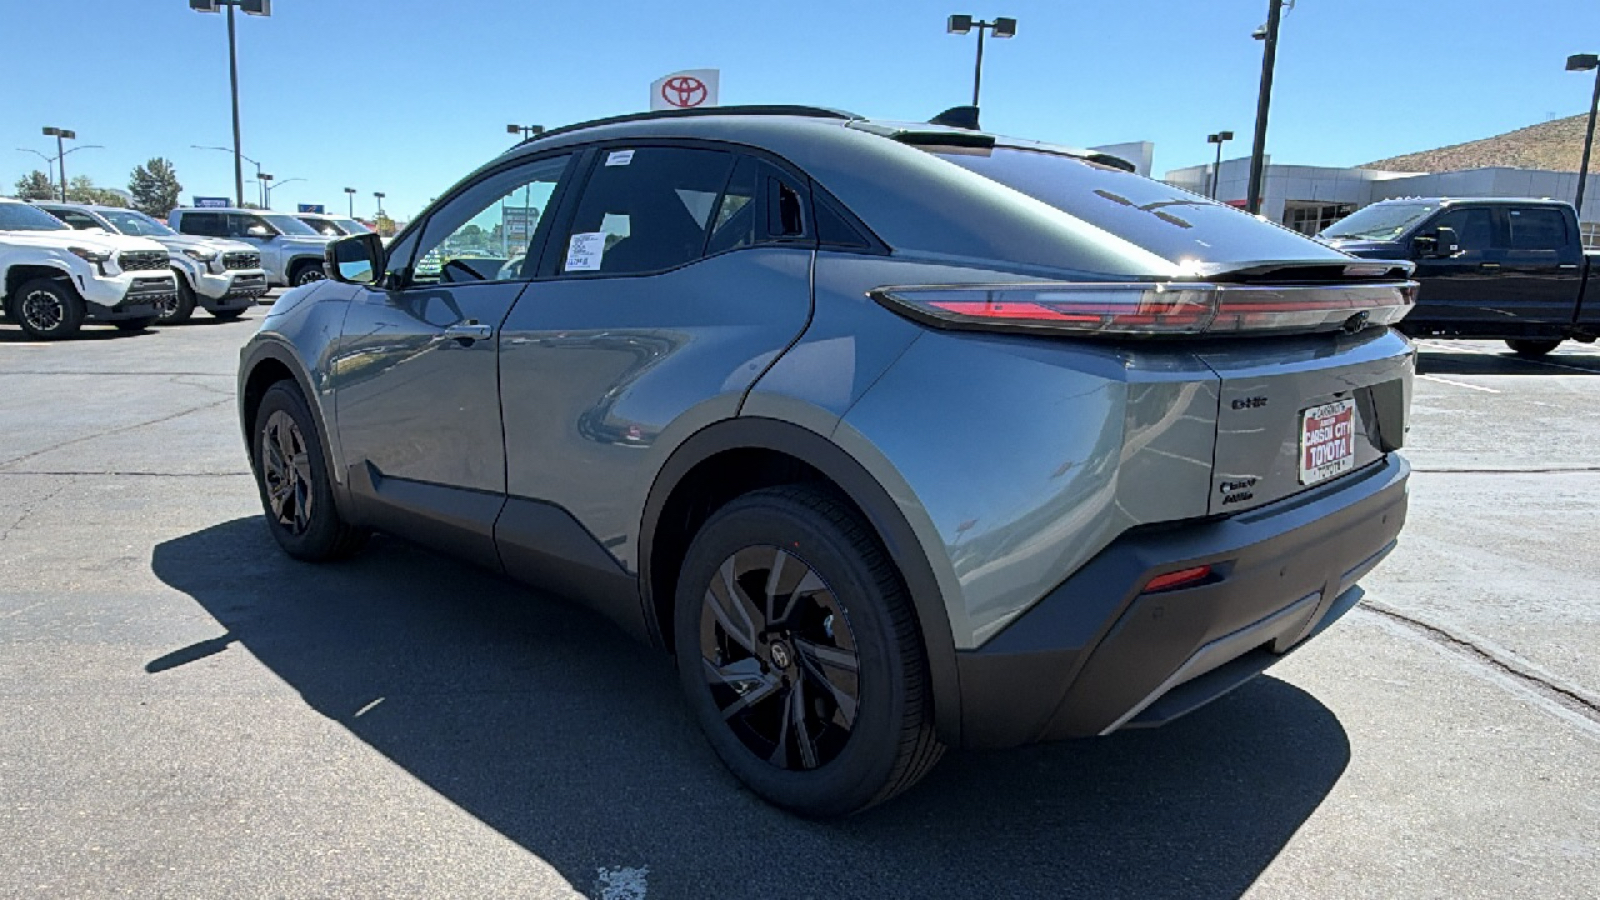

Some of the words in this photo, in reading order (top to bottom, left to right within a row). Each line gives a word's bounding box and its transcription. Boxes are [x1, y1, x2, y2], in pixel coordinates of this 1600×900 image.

[1305, 425, 1334, 446] CARSON
[1334, 420, 1351, 438] CITY
[1310, 439, 1347, 467] TOYOTA
